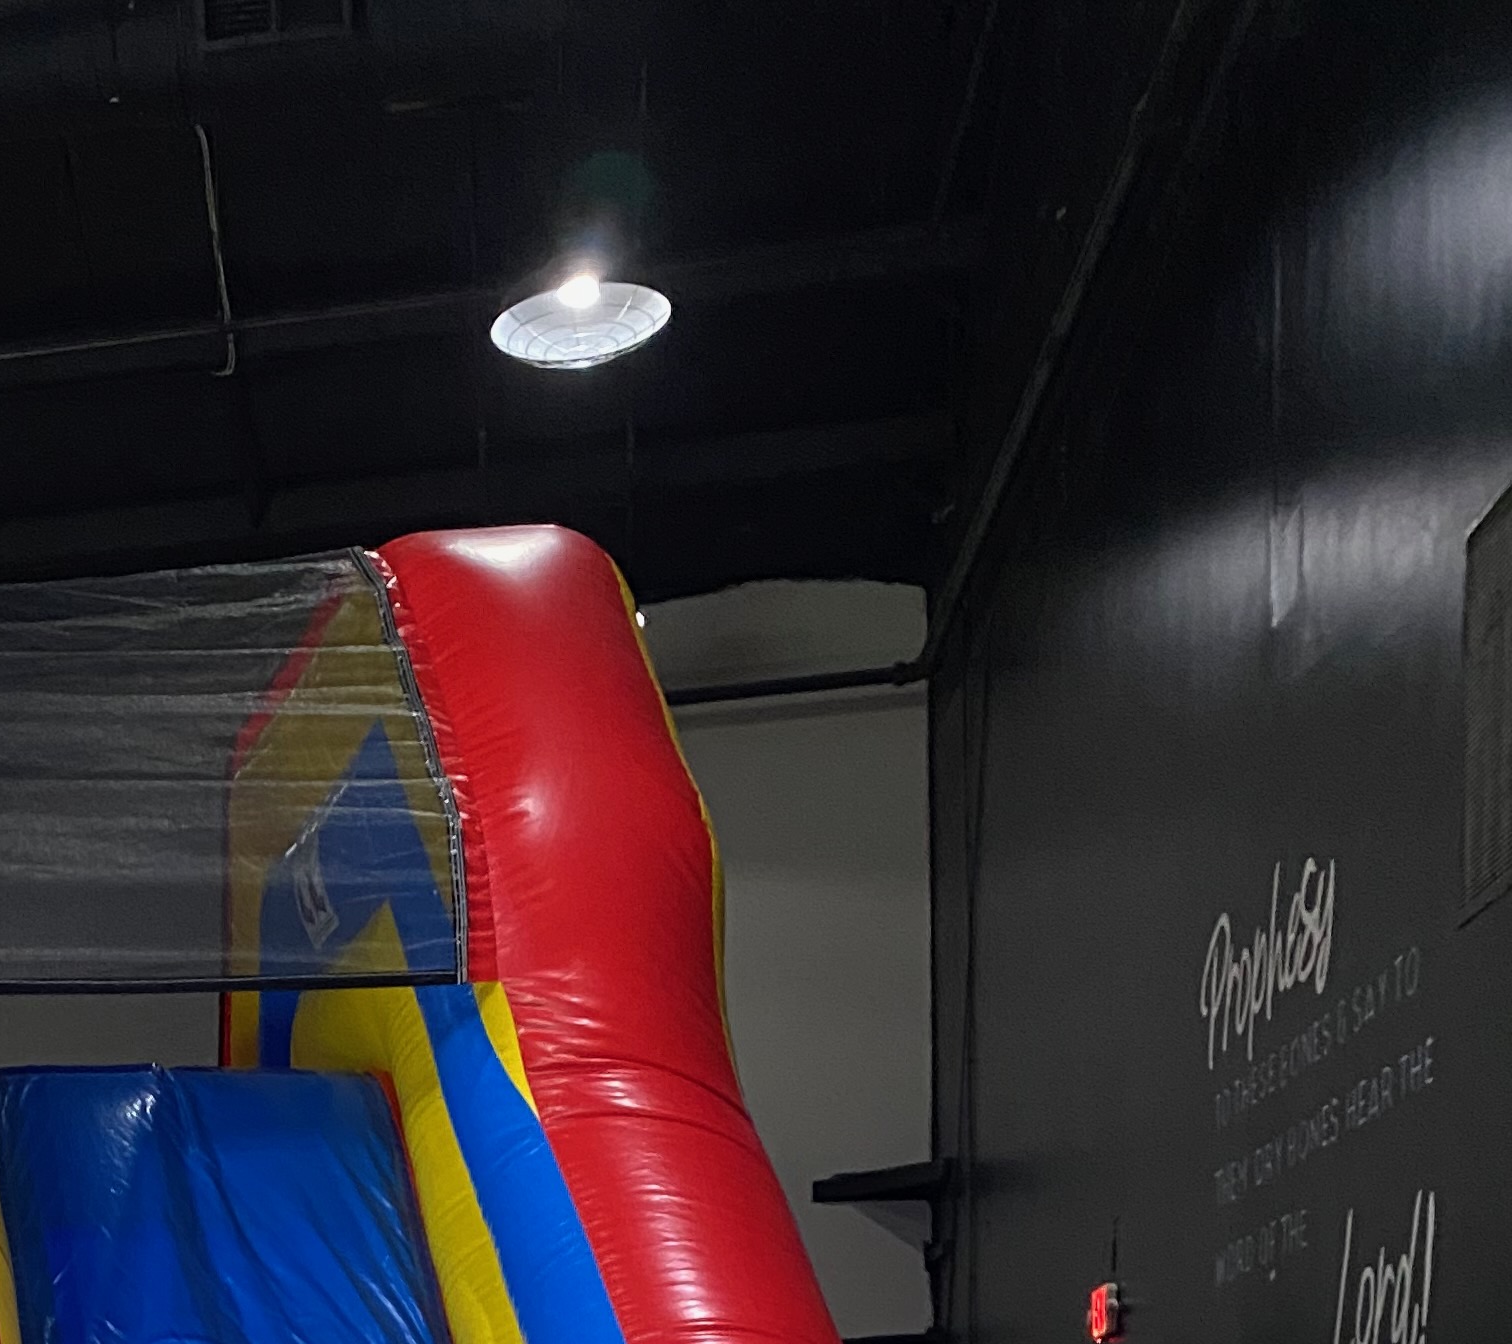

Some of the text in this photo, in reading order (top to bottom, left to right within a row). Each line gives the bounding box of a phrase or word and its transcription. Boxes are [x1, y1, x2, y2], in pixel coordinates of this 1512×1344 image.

[1200, 857, 1335, 1070] Prophesy
[1352, 968, 1388, 1034] SAY
[1393, 945, 1420, 1003] TO
[1345, 1066, 1394, 1132] HEAR
[1398, 1034, 1434, 1103] THE
[1280, 1208, 1308, 1257] THE
